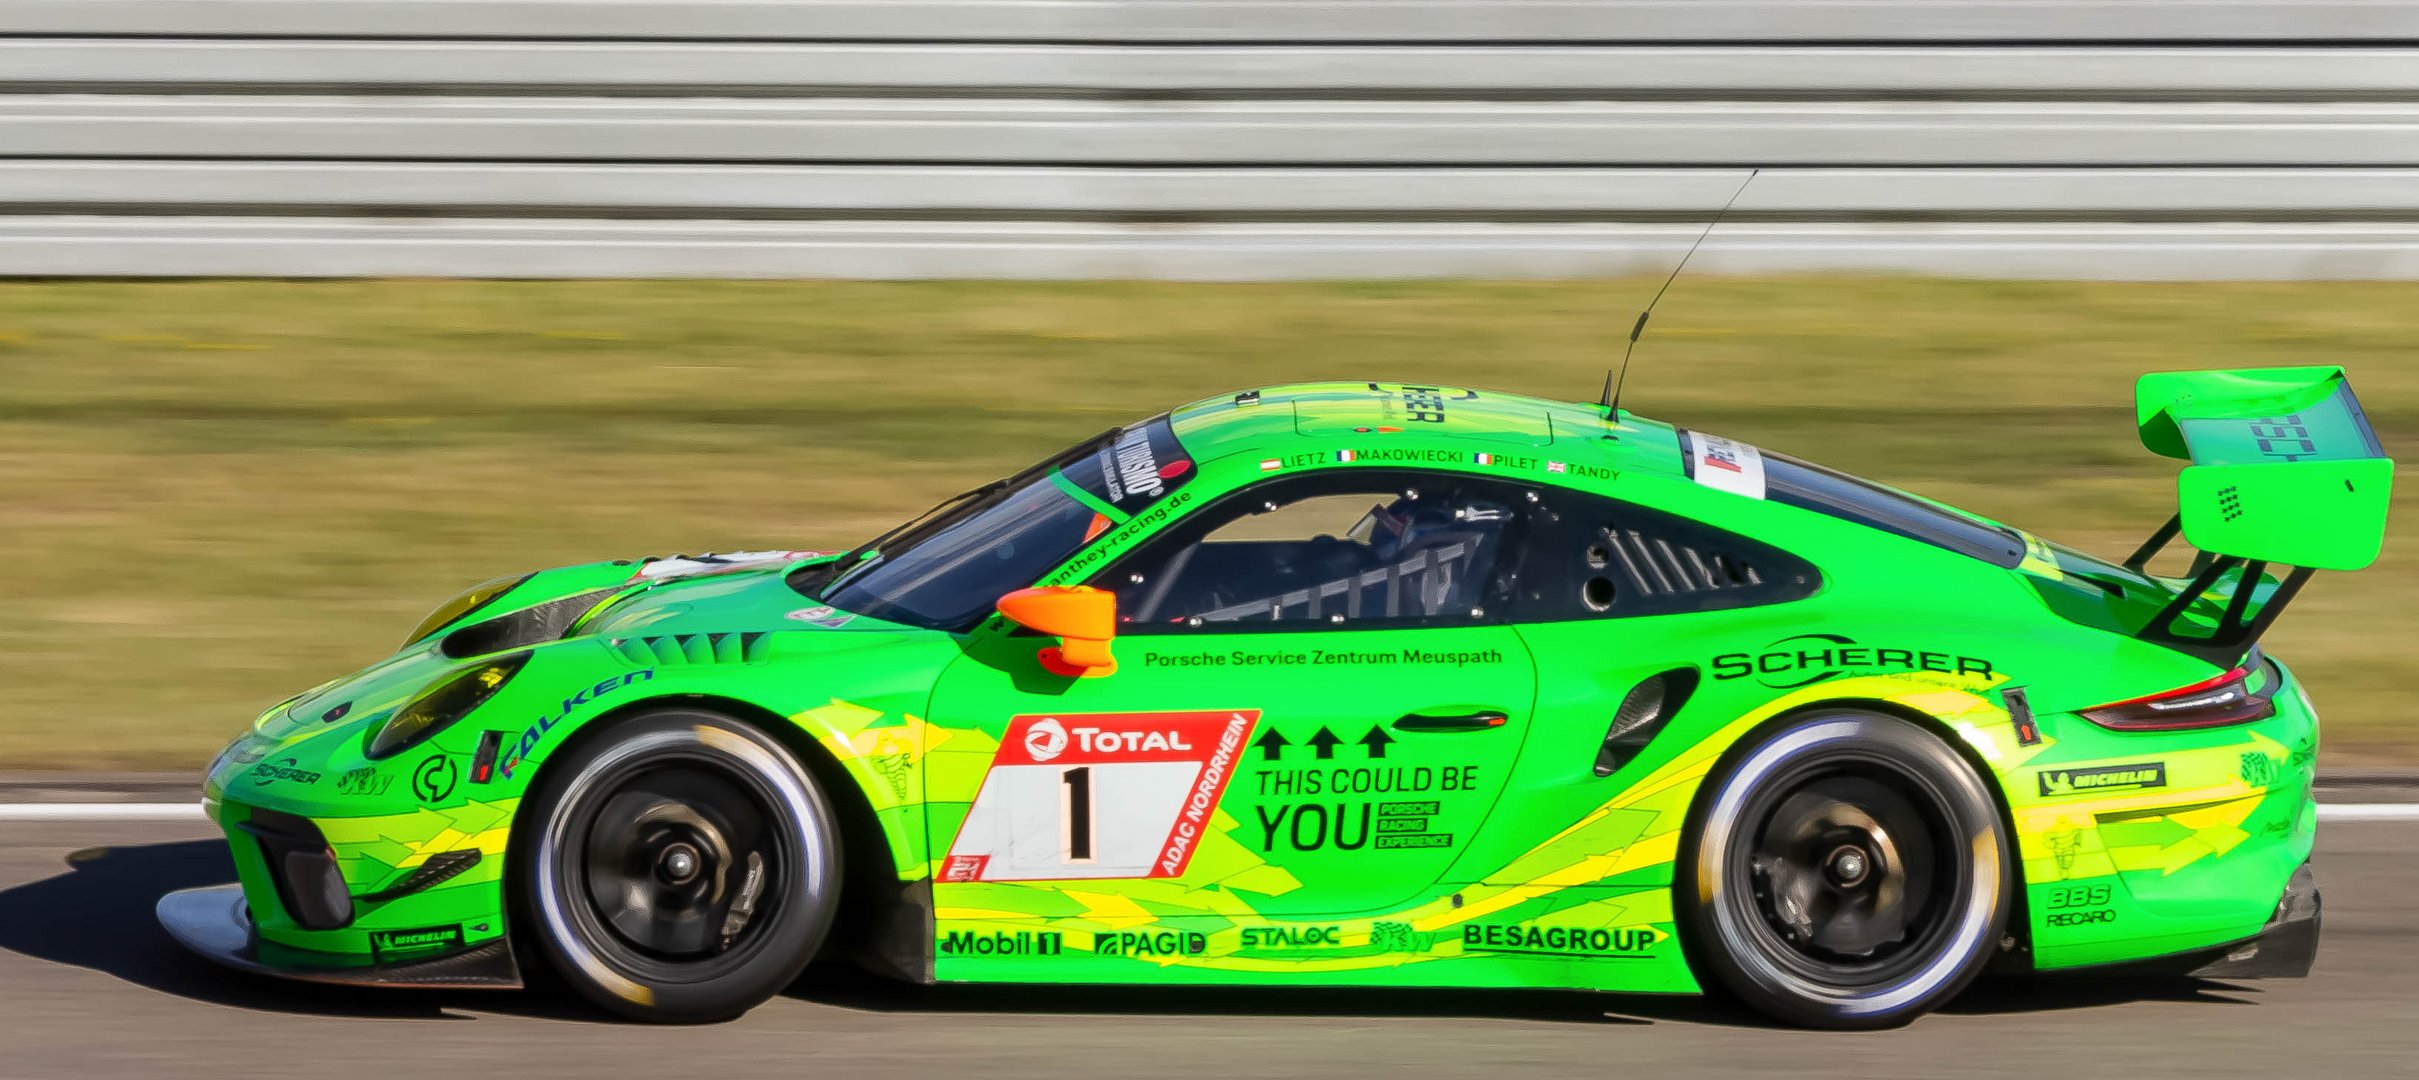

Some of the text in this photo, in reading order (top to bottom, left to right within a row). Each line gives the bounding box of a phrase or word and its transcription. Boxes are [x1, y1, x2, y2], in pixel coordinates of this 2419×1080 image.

[1280, 452, 1327, 469] LIETZ
[1356, 449, 1463, 463] MAKOWIECKI
[1494, 455, 1538, 471] PILET
[1569, 464, 1621, 481] TANDY
[1145, 648, 1503, 667] Porsche Service Zentrum Meuspath
[1711, 647, 1993, 682] SCHERER
[1071, 726, 1192, 752] TOTAL
[1256, 765, 1479, 796] THIS COULD BE
[2073, 769, 2159, 788] MICHELIN
[1161, 712, 1249, 876] ADAC NORDRHEIN
[1062, 766, 1092, 860] 1
[1256, 802, 1372, 852] YOU
[2047, 883, 2112, 910] BBS
[2046, 909, 2117, 928] RECARO
[949, 931, 1030, 955] Mobil
[1122, 931, 1207, 955] PAGID
[1240, 925, 1340, 947] STALOC
[1463, 924, 1657, 952] BESAGROUP
